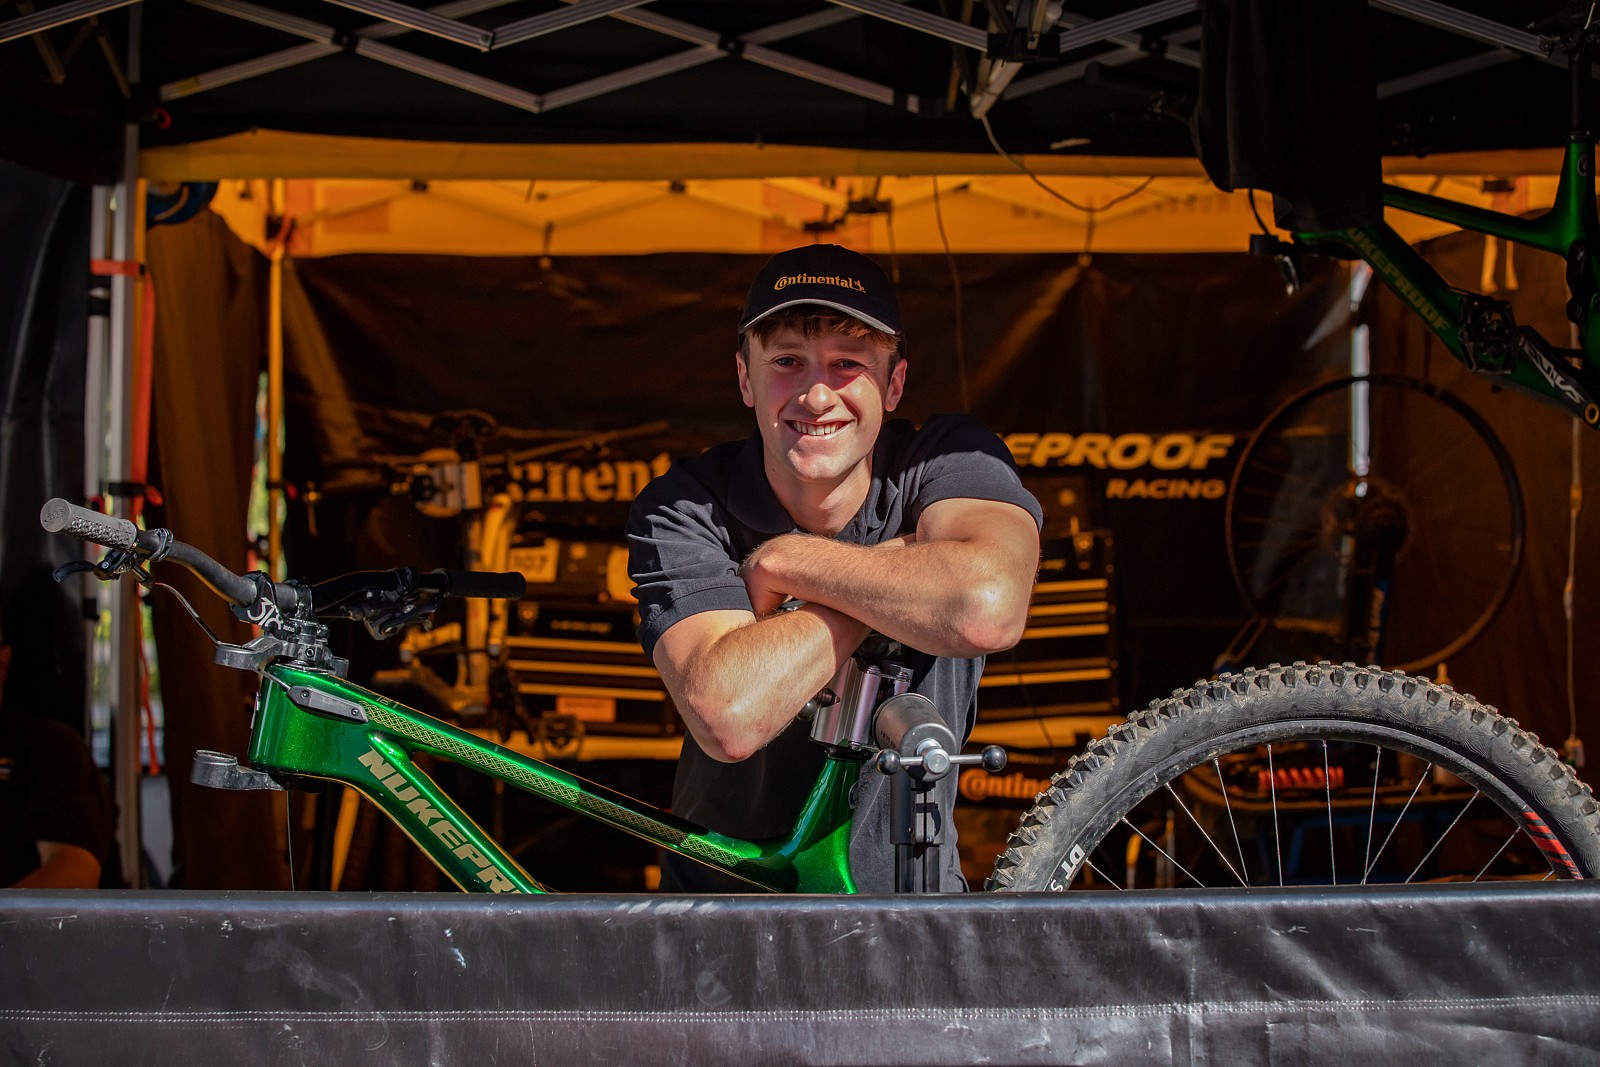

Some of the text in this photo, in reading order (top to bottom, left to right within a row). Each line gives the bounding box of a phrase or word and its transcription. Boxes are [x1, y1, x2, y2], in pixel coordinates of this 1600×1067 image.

[774, 273, 854, 291] Continental
[996, 432, 1235, 470] EPROOF
[1105, 478, 1226, 500] RACING
[357, 749, 523, 893] NUKEPR
[1061, 844, 1086, 880] DT
